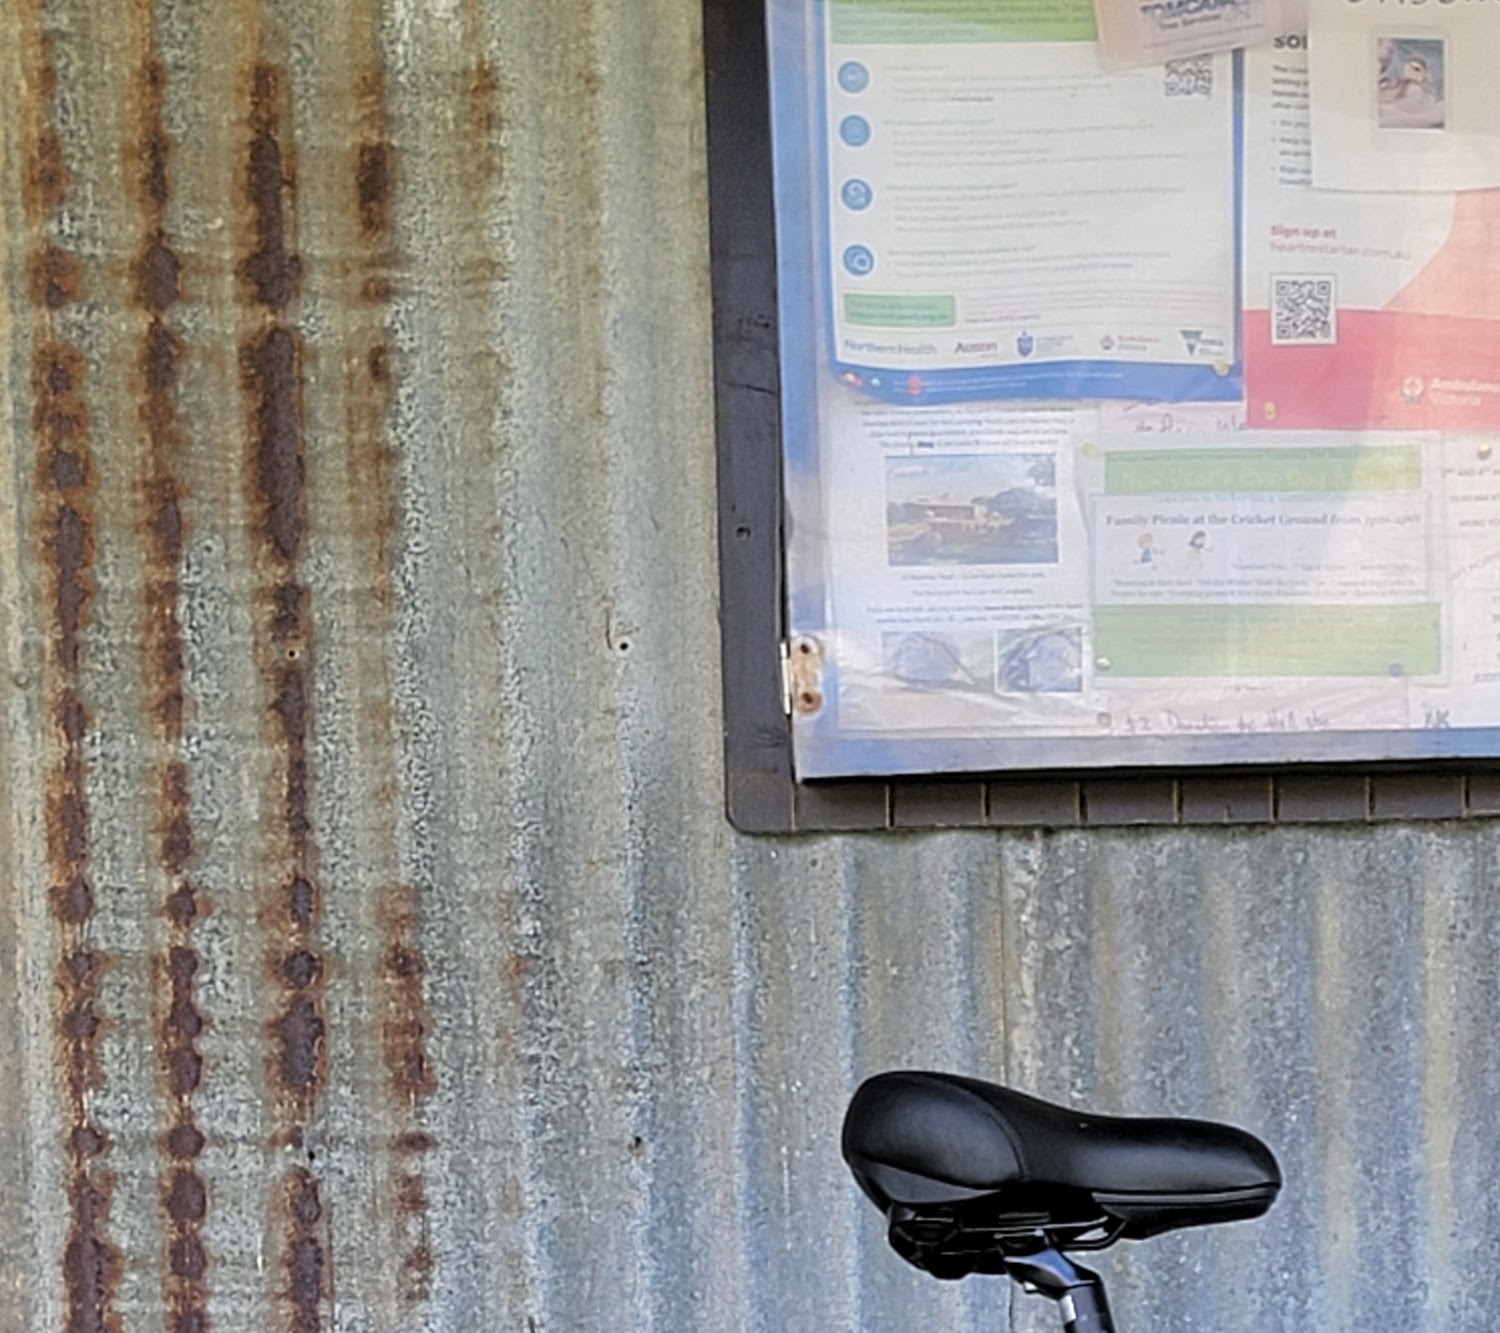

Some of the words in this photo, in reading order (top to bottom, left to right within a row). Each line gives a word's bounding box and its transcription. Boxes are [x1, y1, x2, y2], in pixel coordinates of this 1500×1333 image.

[1303, 228, 1320, 238] up
[1323, 228, 1336, 238] at
[1106, 515, 1148, 527] Family
[1152, 515, 1189, 525] Picnic
[1193, 516, 1205, 525] at
[1208, 515, 1228, 525] the
[1231, 514, 1275, 525] Cricket
[1279, 514, 1327, 525] Ground
